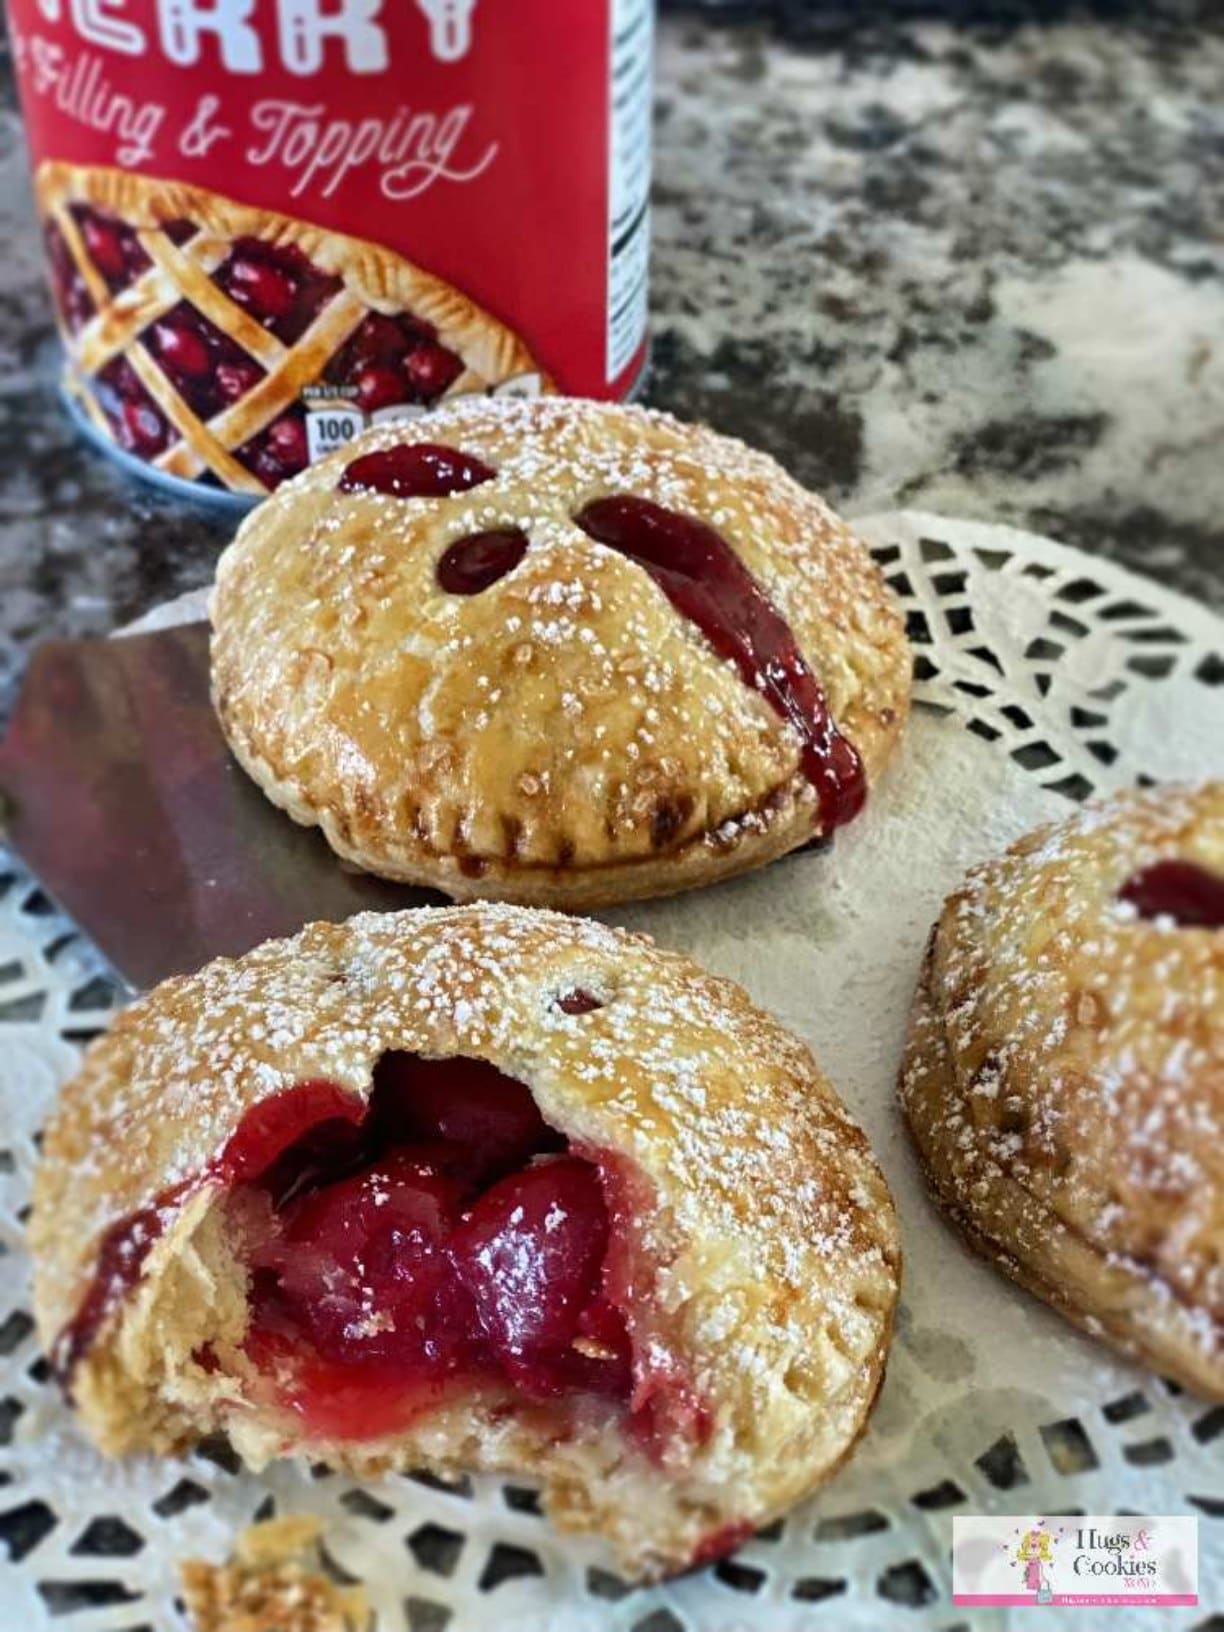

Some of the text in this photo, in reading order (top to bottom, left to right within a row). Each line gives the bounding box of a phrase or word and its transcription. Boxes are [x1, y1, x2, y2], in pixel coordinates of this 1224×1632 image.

[38, 0, 478, 76] ERRY
[31, 36, 498, 200] Filling & Topping
[316, 417, 354, 442] 100
